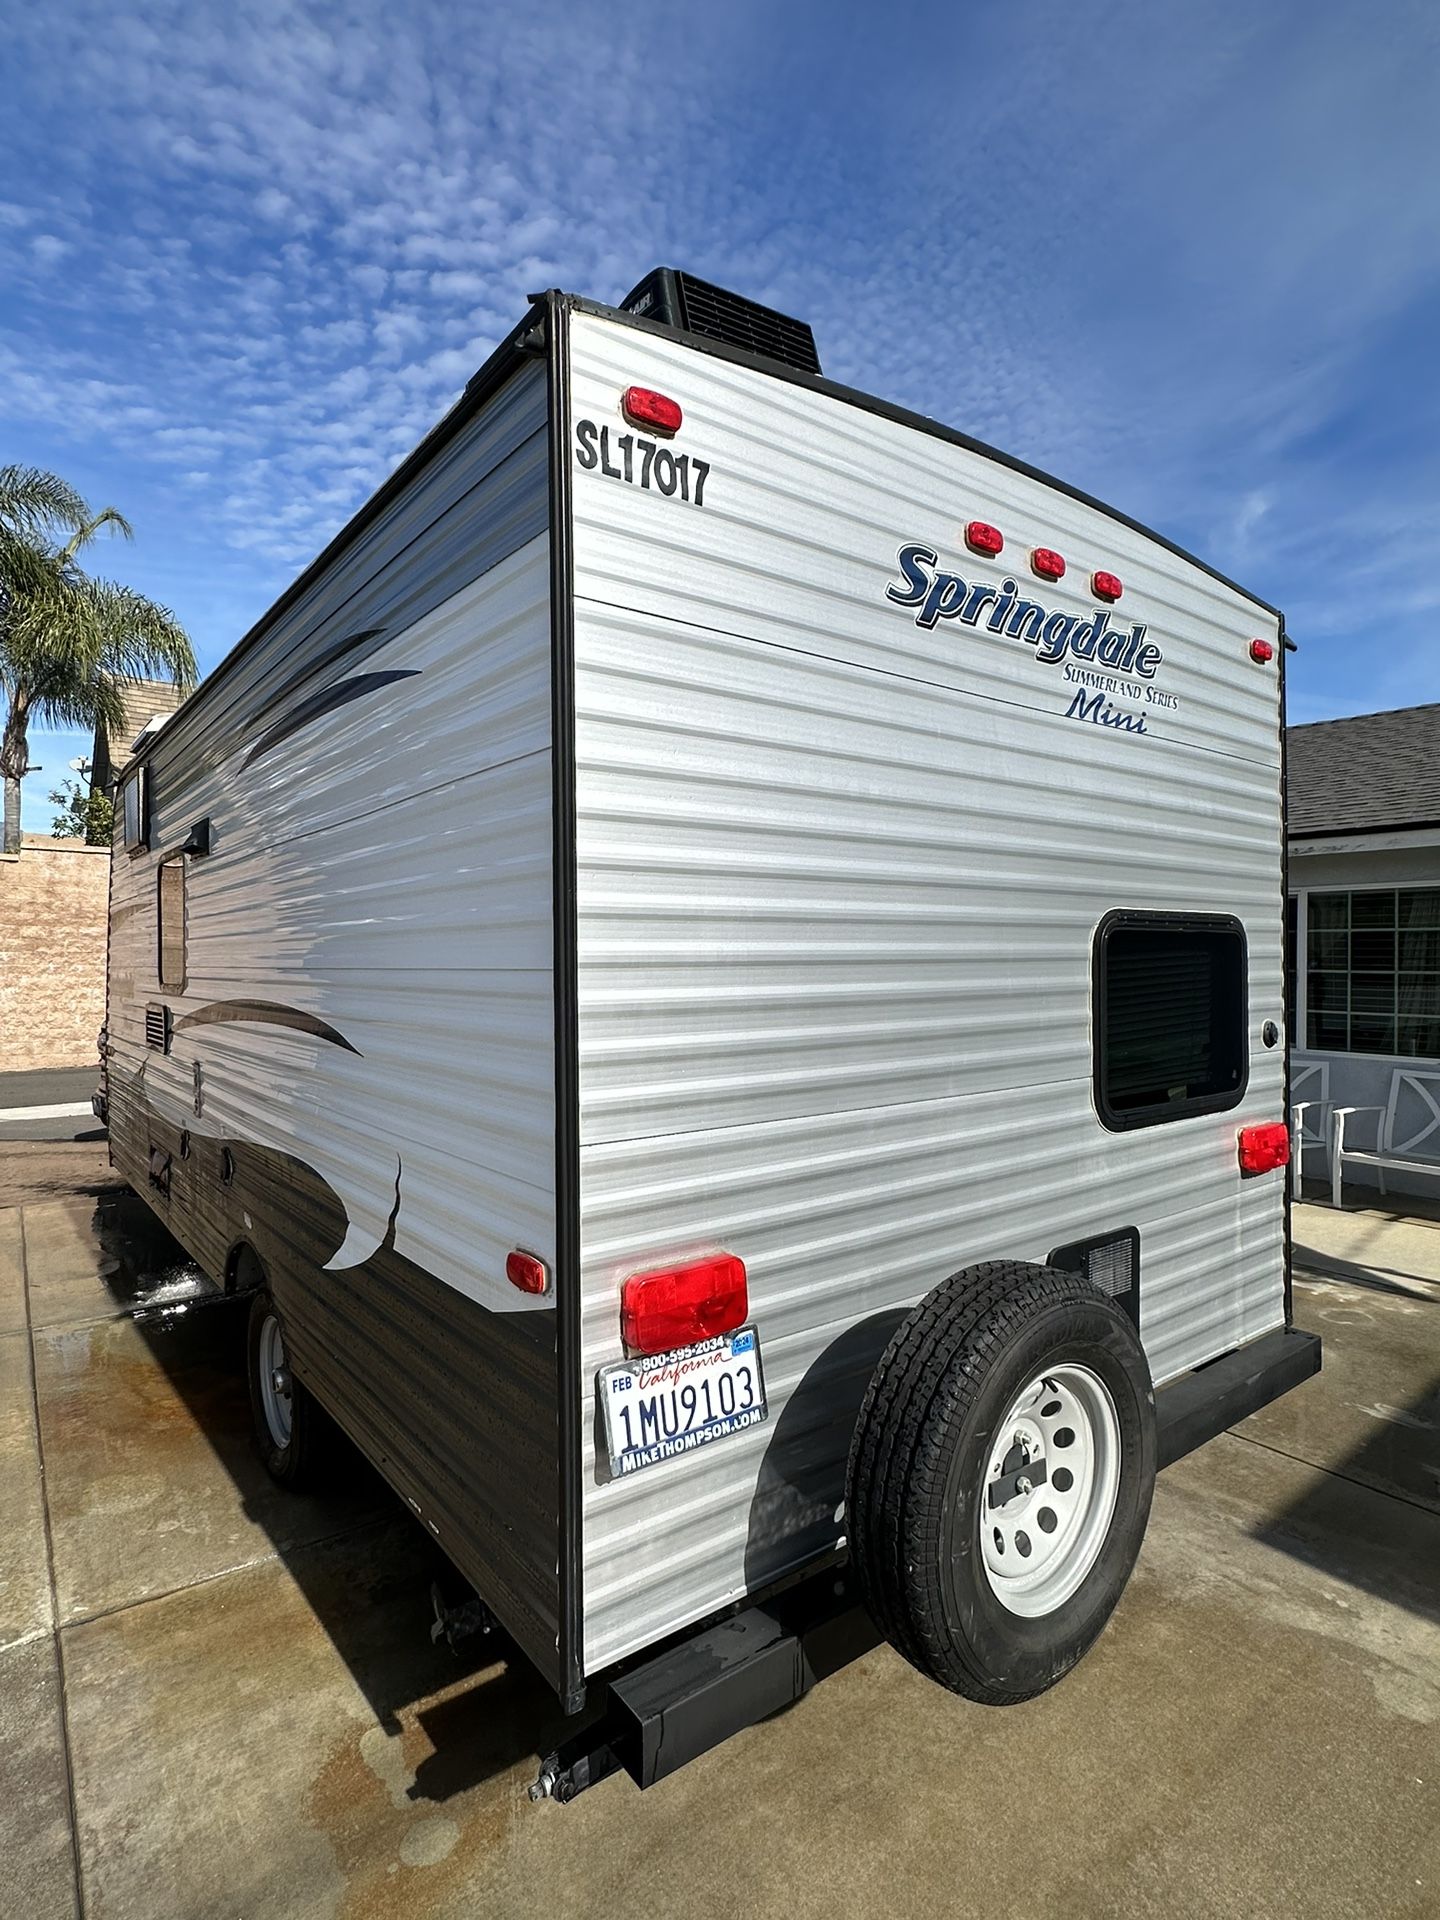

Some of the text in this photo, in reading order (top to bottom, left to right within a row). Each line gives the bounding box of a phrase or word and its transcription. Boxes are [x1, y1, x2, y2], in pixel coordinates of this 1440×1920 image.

[575, 419, 711, 507] SL17017
[886, 542, 1164, 680] Springdale
[1062, 662, 1180, 710] SUMMERLAND SERIES
[1064, 687, 1148, 735] Mini
[612, 1376, 632, 1394] FEB
[638, 1351, 733, 1390] California
[618, 1366, 755, 1455] 1MU9103
